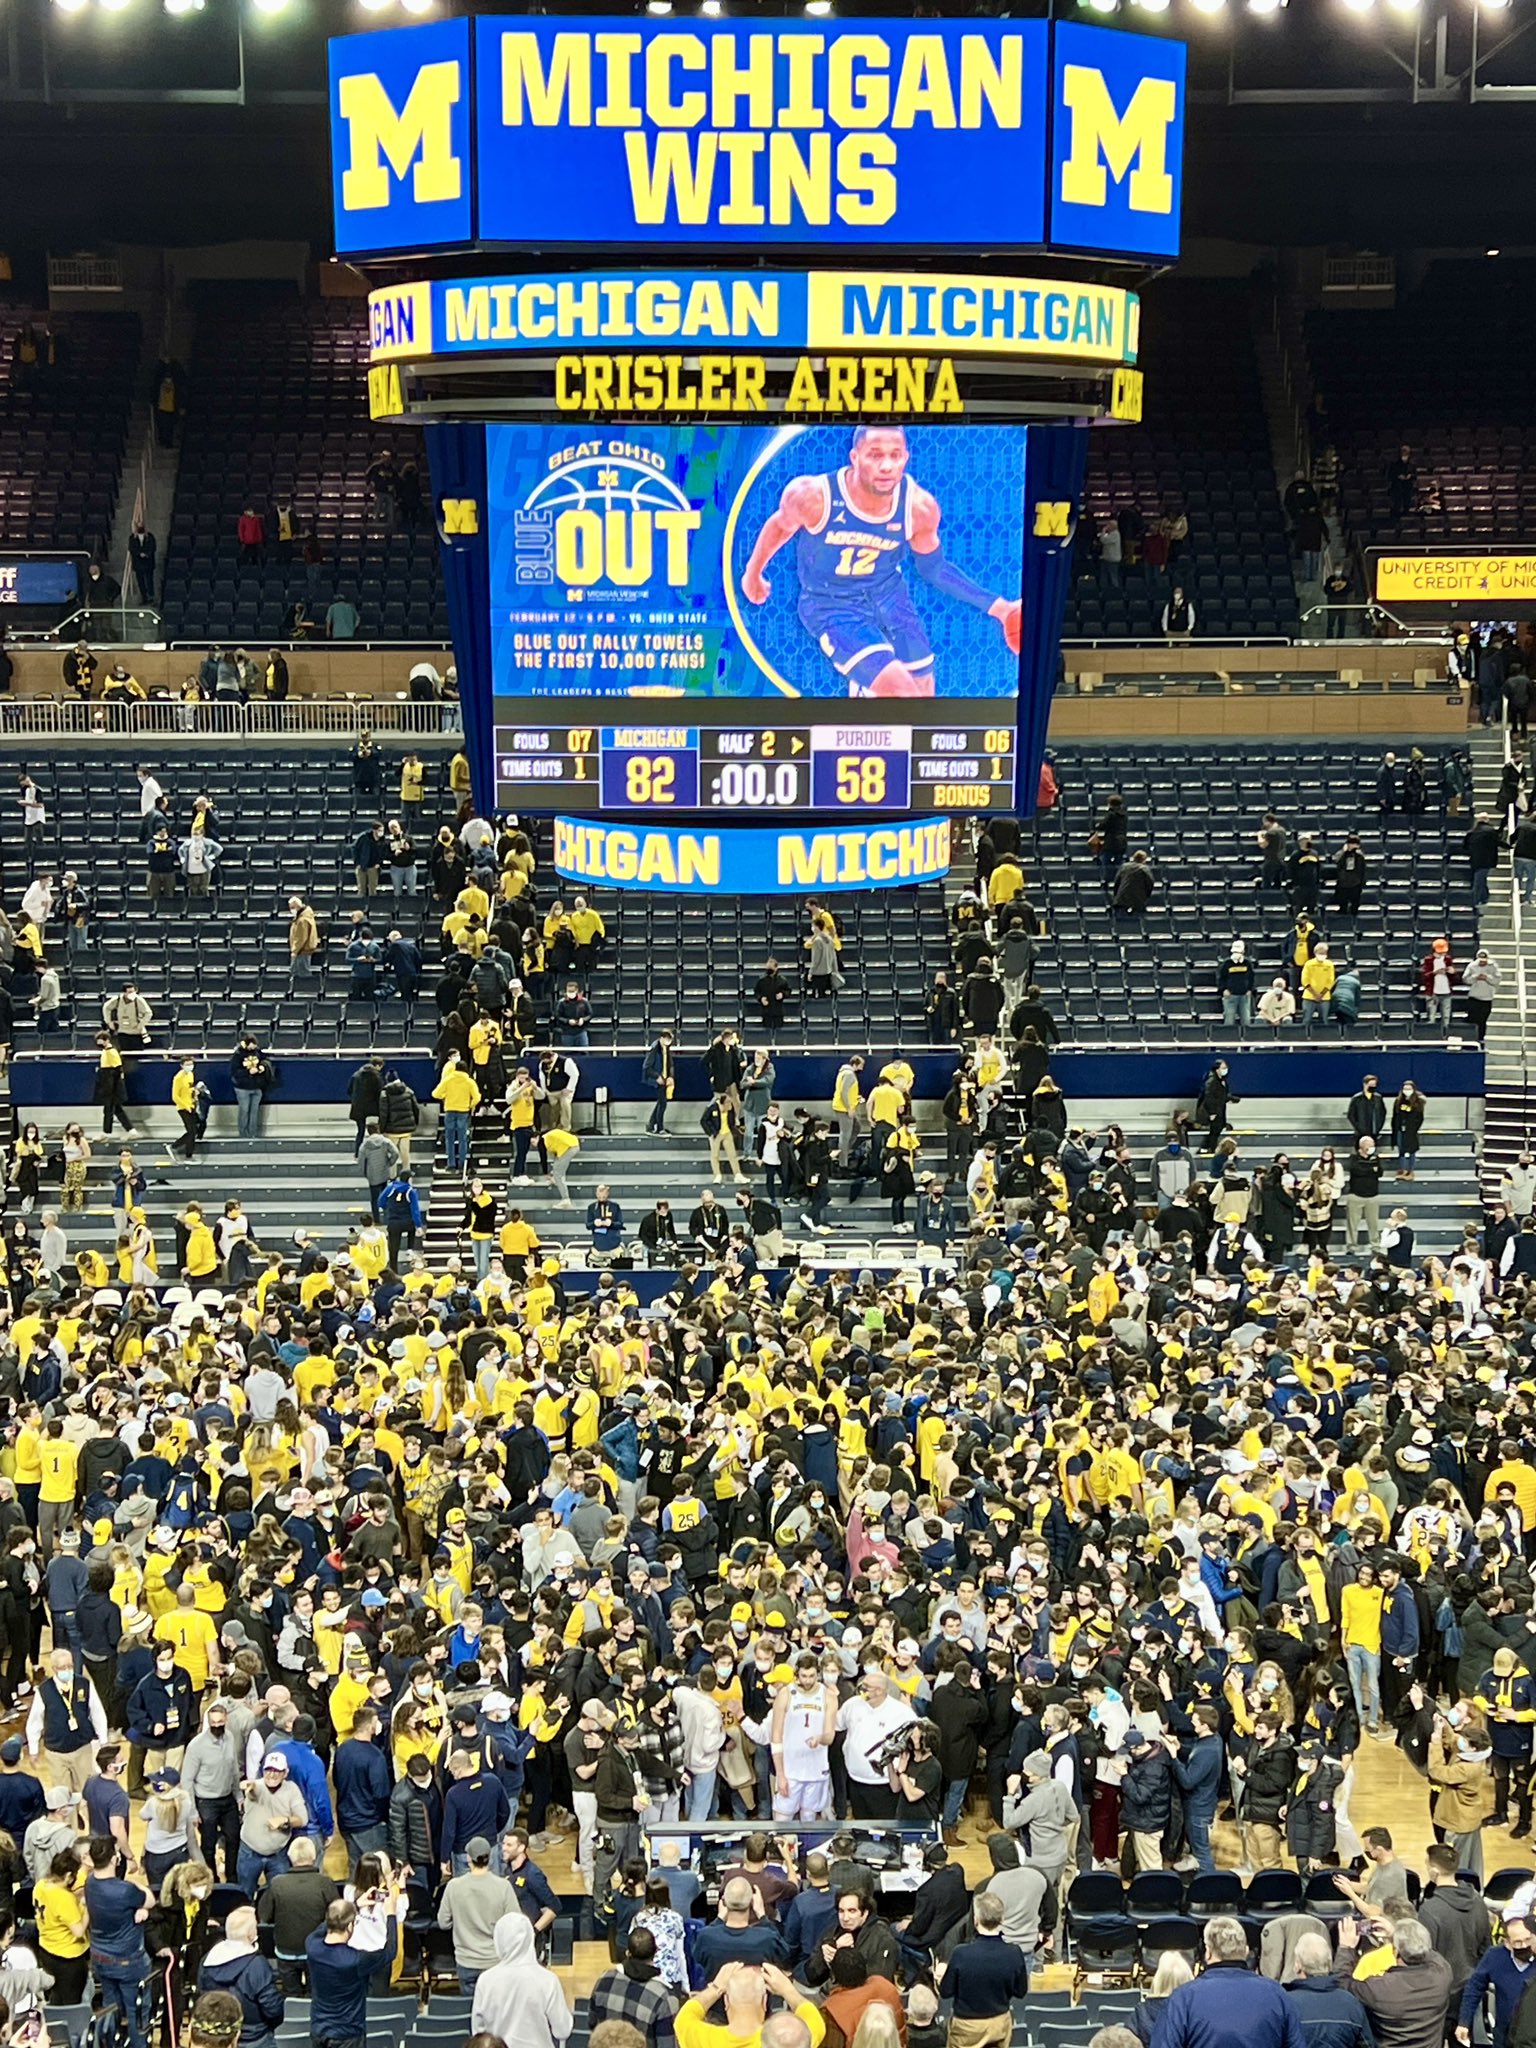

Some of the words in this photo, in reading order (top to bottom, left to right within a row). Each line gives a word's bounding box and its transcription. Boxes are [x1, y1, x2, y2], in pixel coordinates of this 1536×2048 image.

[501, 32, 1023, 130] MICHIGAN
[339, 60, 462, 211] M
[1061, 64, 1177, 214] M
[624, 132, 897, 226] WINS
[369, 294, 415, 350] GAN
[445, 279, 779, 342] MICHIGAN
[842, 284, 1115, 347] MICHIGAN
[555, 356, 767, 413] CRISLER
[785, 357, 965, 413] ARENA
[548, 440, 603, 470] BEAT
[608, 440, 666, 471] OHIO
[597, 470, 619, 487] M
[441, 498, 479, 535] M
[1033, 501, 1072, 537] M
[514, 510, 554, 585] BLUE
[555, 510, 701, 586] OUT
[834, 546, 881, 577] 12
[1382, 561, 1482, 575] UNIVERSITY
[1486, 560, 1509, 574] OF
[1413, 576, 1473, 590] CREDIT
[513, 633, 552, 651] BLUE
[557, 633, 587, 650] OUT
[592, 634, 639, 651] RALLY
[643, 634, 704, 651] TOWELS
[514, 652, 543, 669] THE
[548, 652, 594, 669] FIRST
[599, 653, 655, 671] 10,000
[660, 653, 706, 670] FANS!
[513, 732, 550, 751] FOULS
[567, 730, 593, 753] 07
[613, 730, 688, 748] MICHIGAN
[718, 734, 754, 754] HALF
[761, 731, 776, 757] 2
[835, 730, 892, 748] PURDUE
[931, 733, 967, 751] FOULS
[984, 730, 1010, 753] 06
[501, 760, 532, 777] TIME
[533, 760, 563, 777] OUTS
[574, 757, 587, 780] 1
[626, 755, 676, 804] 82
[836, 755, 886, 804] 58
[917, 760, 948, 778] TIME
[949, 761, 979, 778] OUTS
[990, 757, 1003, 780] 1
[711, 763, 798, 805] :00.0
[933, 784, 991, 807] BONUS
[958, 906, 975, 919] M
[541, 1335, 555, 1347] 25
[53, 1456, 59, 1473] 1
[678, 1513, 694, 1529] 25
[179, 1627, 187, 1647] 1
[804, 1712, 810, 1728] 1
